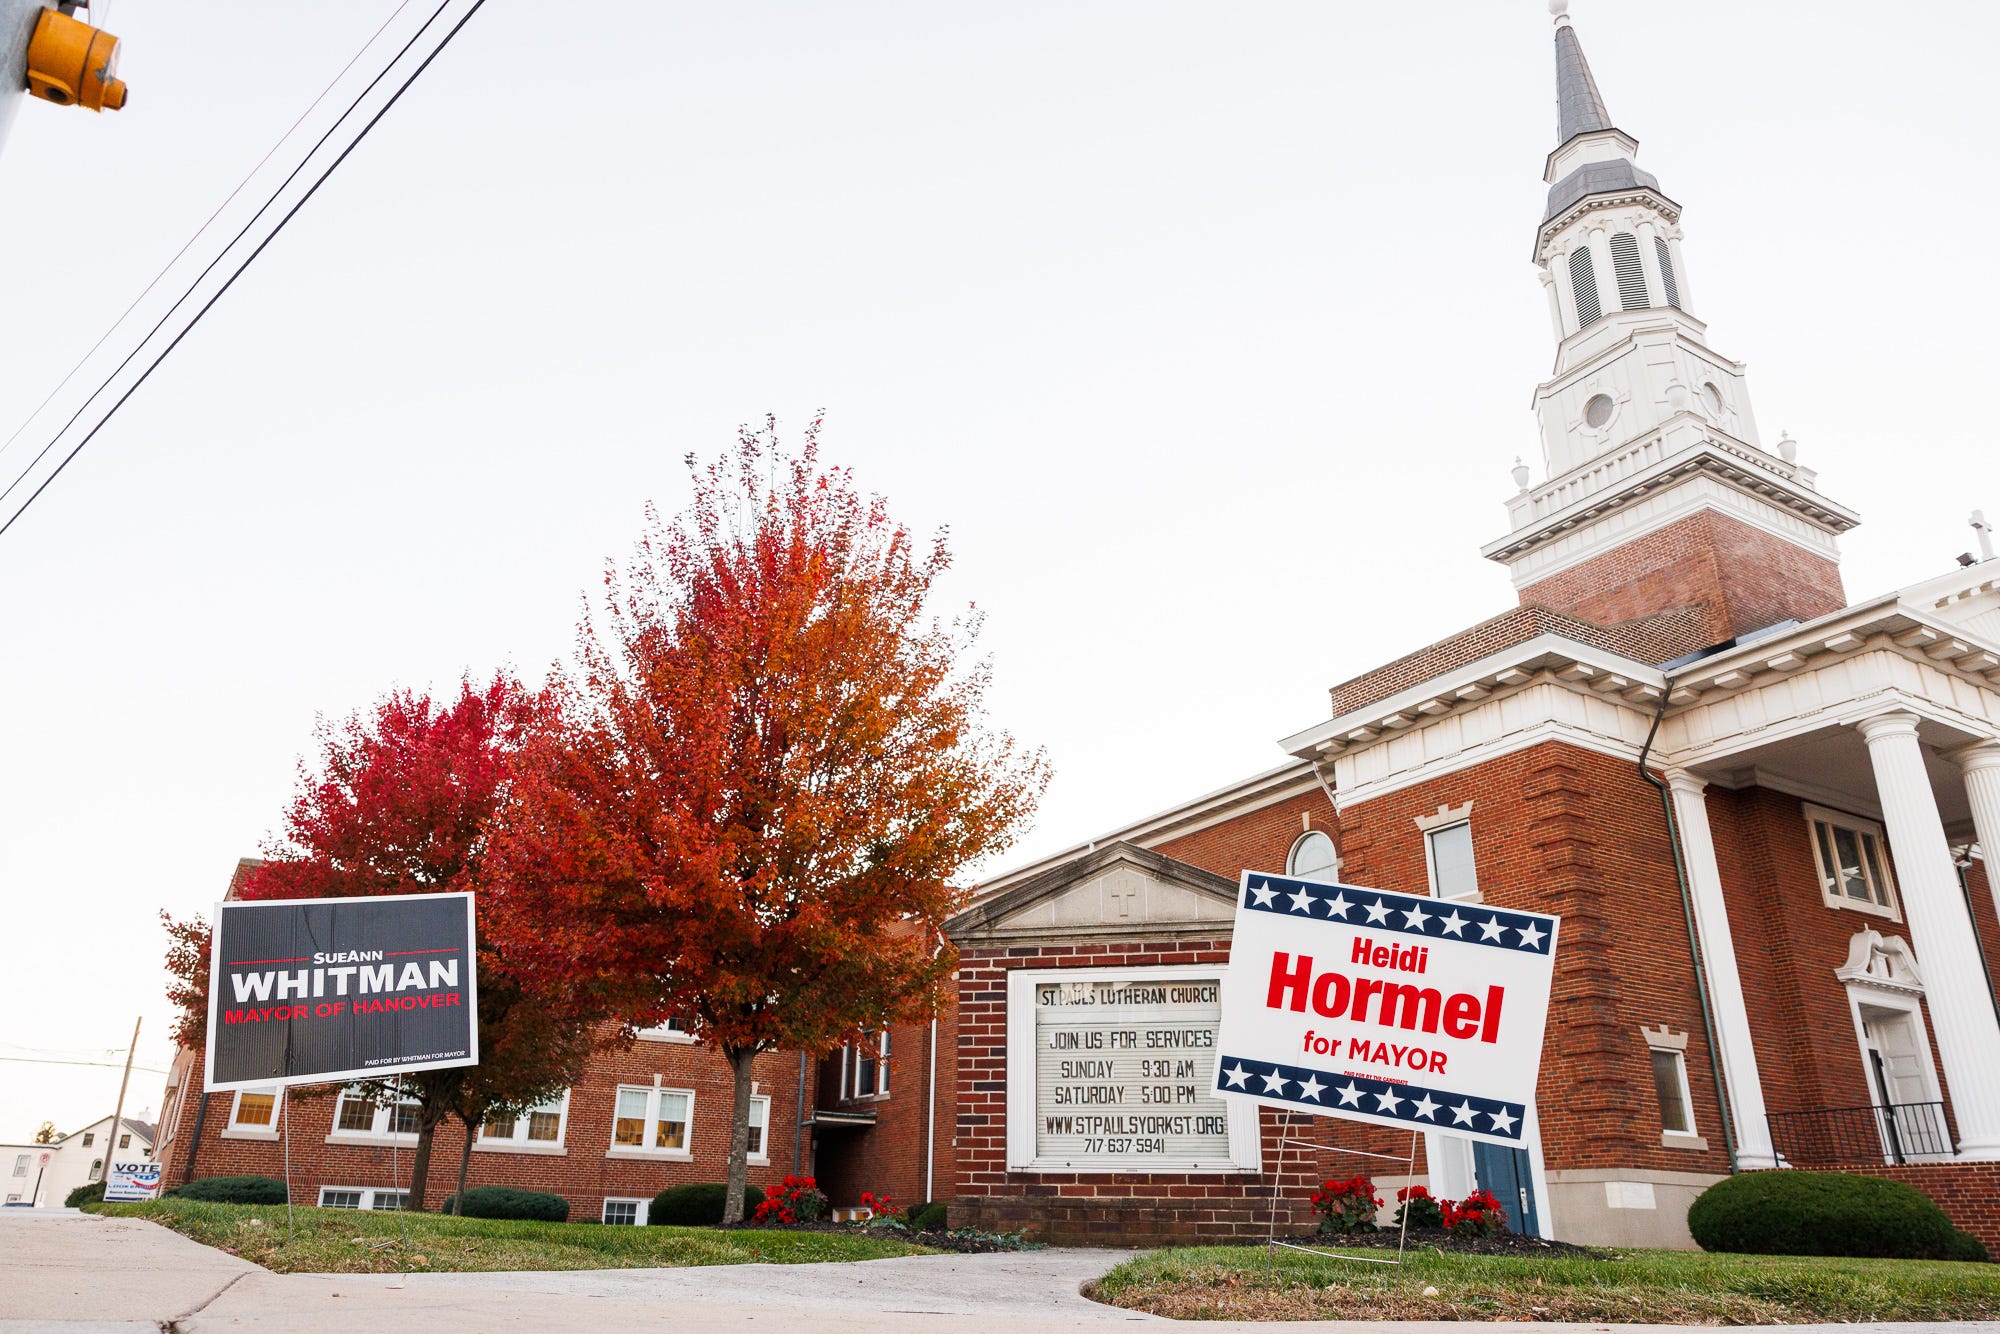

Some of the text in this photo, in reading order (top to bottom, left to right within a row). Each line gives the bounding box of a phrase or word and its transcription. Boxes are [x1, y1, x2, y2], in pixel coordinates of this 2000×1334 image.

[1351, 936, 1429, 974] Heidi
[231, 959, 458, 1003] WHITMAN
[1042, 990, 1056, 1006] ST.
[1101, 987, 1166, 1005] LUTHERAN
[1171, 987, 1217, 1003] CHURCH
[1266, 951, 1505, 1044] Hormel
[225, 992, 461, 1025] MAYOR OF HANOVER
[1050, 1030, 1212, 1050] JOIN US FOR SERVICES
[380, 1057, 393, 1065] FOR
[1303, 1030, 1448, 1075] for MAYOR
[1061, 1060, 1195, 1079] SUNDAY 9:30 AM
[1055, 1085, 1196, 1105] SATURDAY 5:00 PM
[1046, 1116, 1225, 1135] WWW.STPAULSYORKST.ORG
[116, 1163, 160, 1172] VOTE
